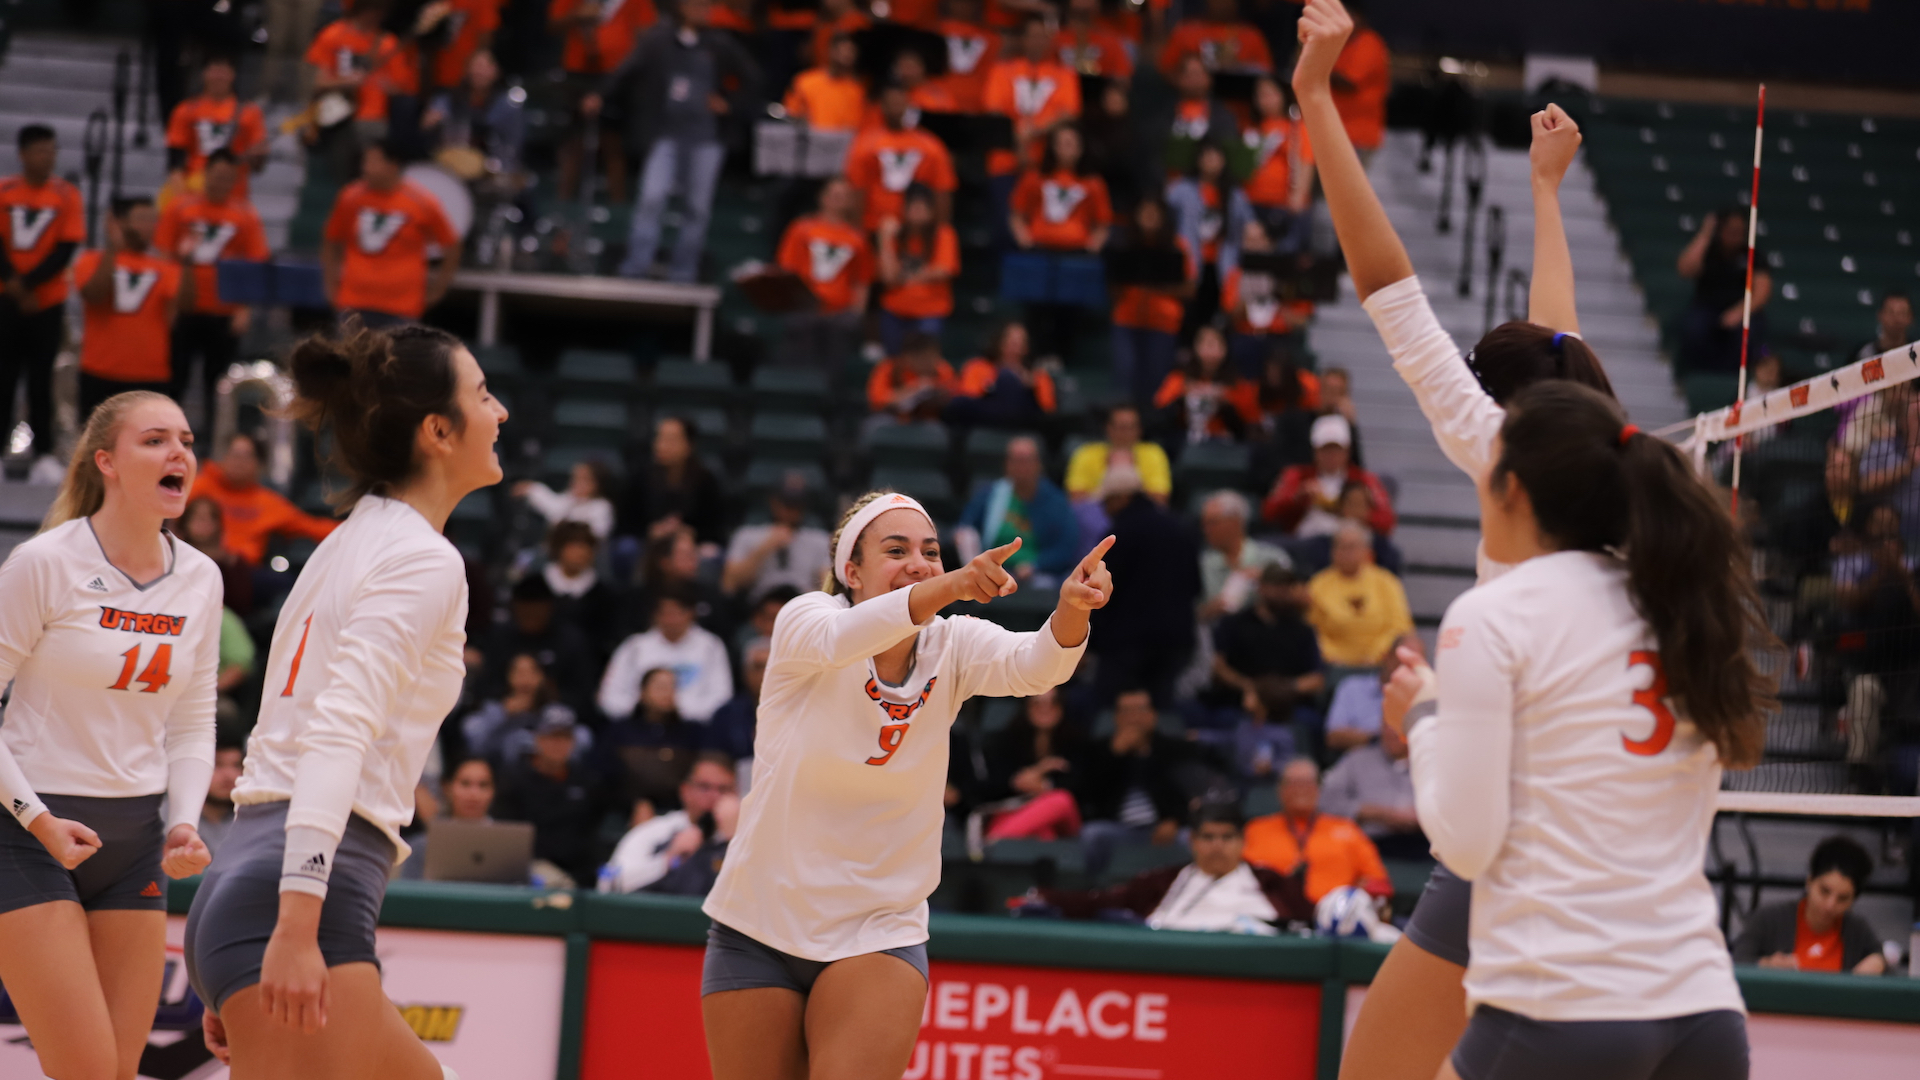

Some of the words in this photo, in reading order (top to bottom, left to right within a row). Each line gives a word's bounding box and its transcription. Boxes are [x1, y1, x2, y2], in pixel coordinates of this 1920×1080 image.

[1013, 75, 1056, 115] V
[877, 148, 923, 191] V
[1042, 180, 1087, 222] V
[11, 205, 57, 250] V
[357, 206, 408, 252] V
[809, 238, 855, 281] V
[113, 266, 158, 313] V
[99, 605, 187, 636] UTRGV
[106, 642, 173, 694] 14
[280, 610, 315, 697] 1
[1619, 649, 1677, 758] 3
[864, 722, 910, 766] 9
[920, 981, 1169, 1042] EPLACE
[902, 1040, 1044, 1080] UITES
